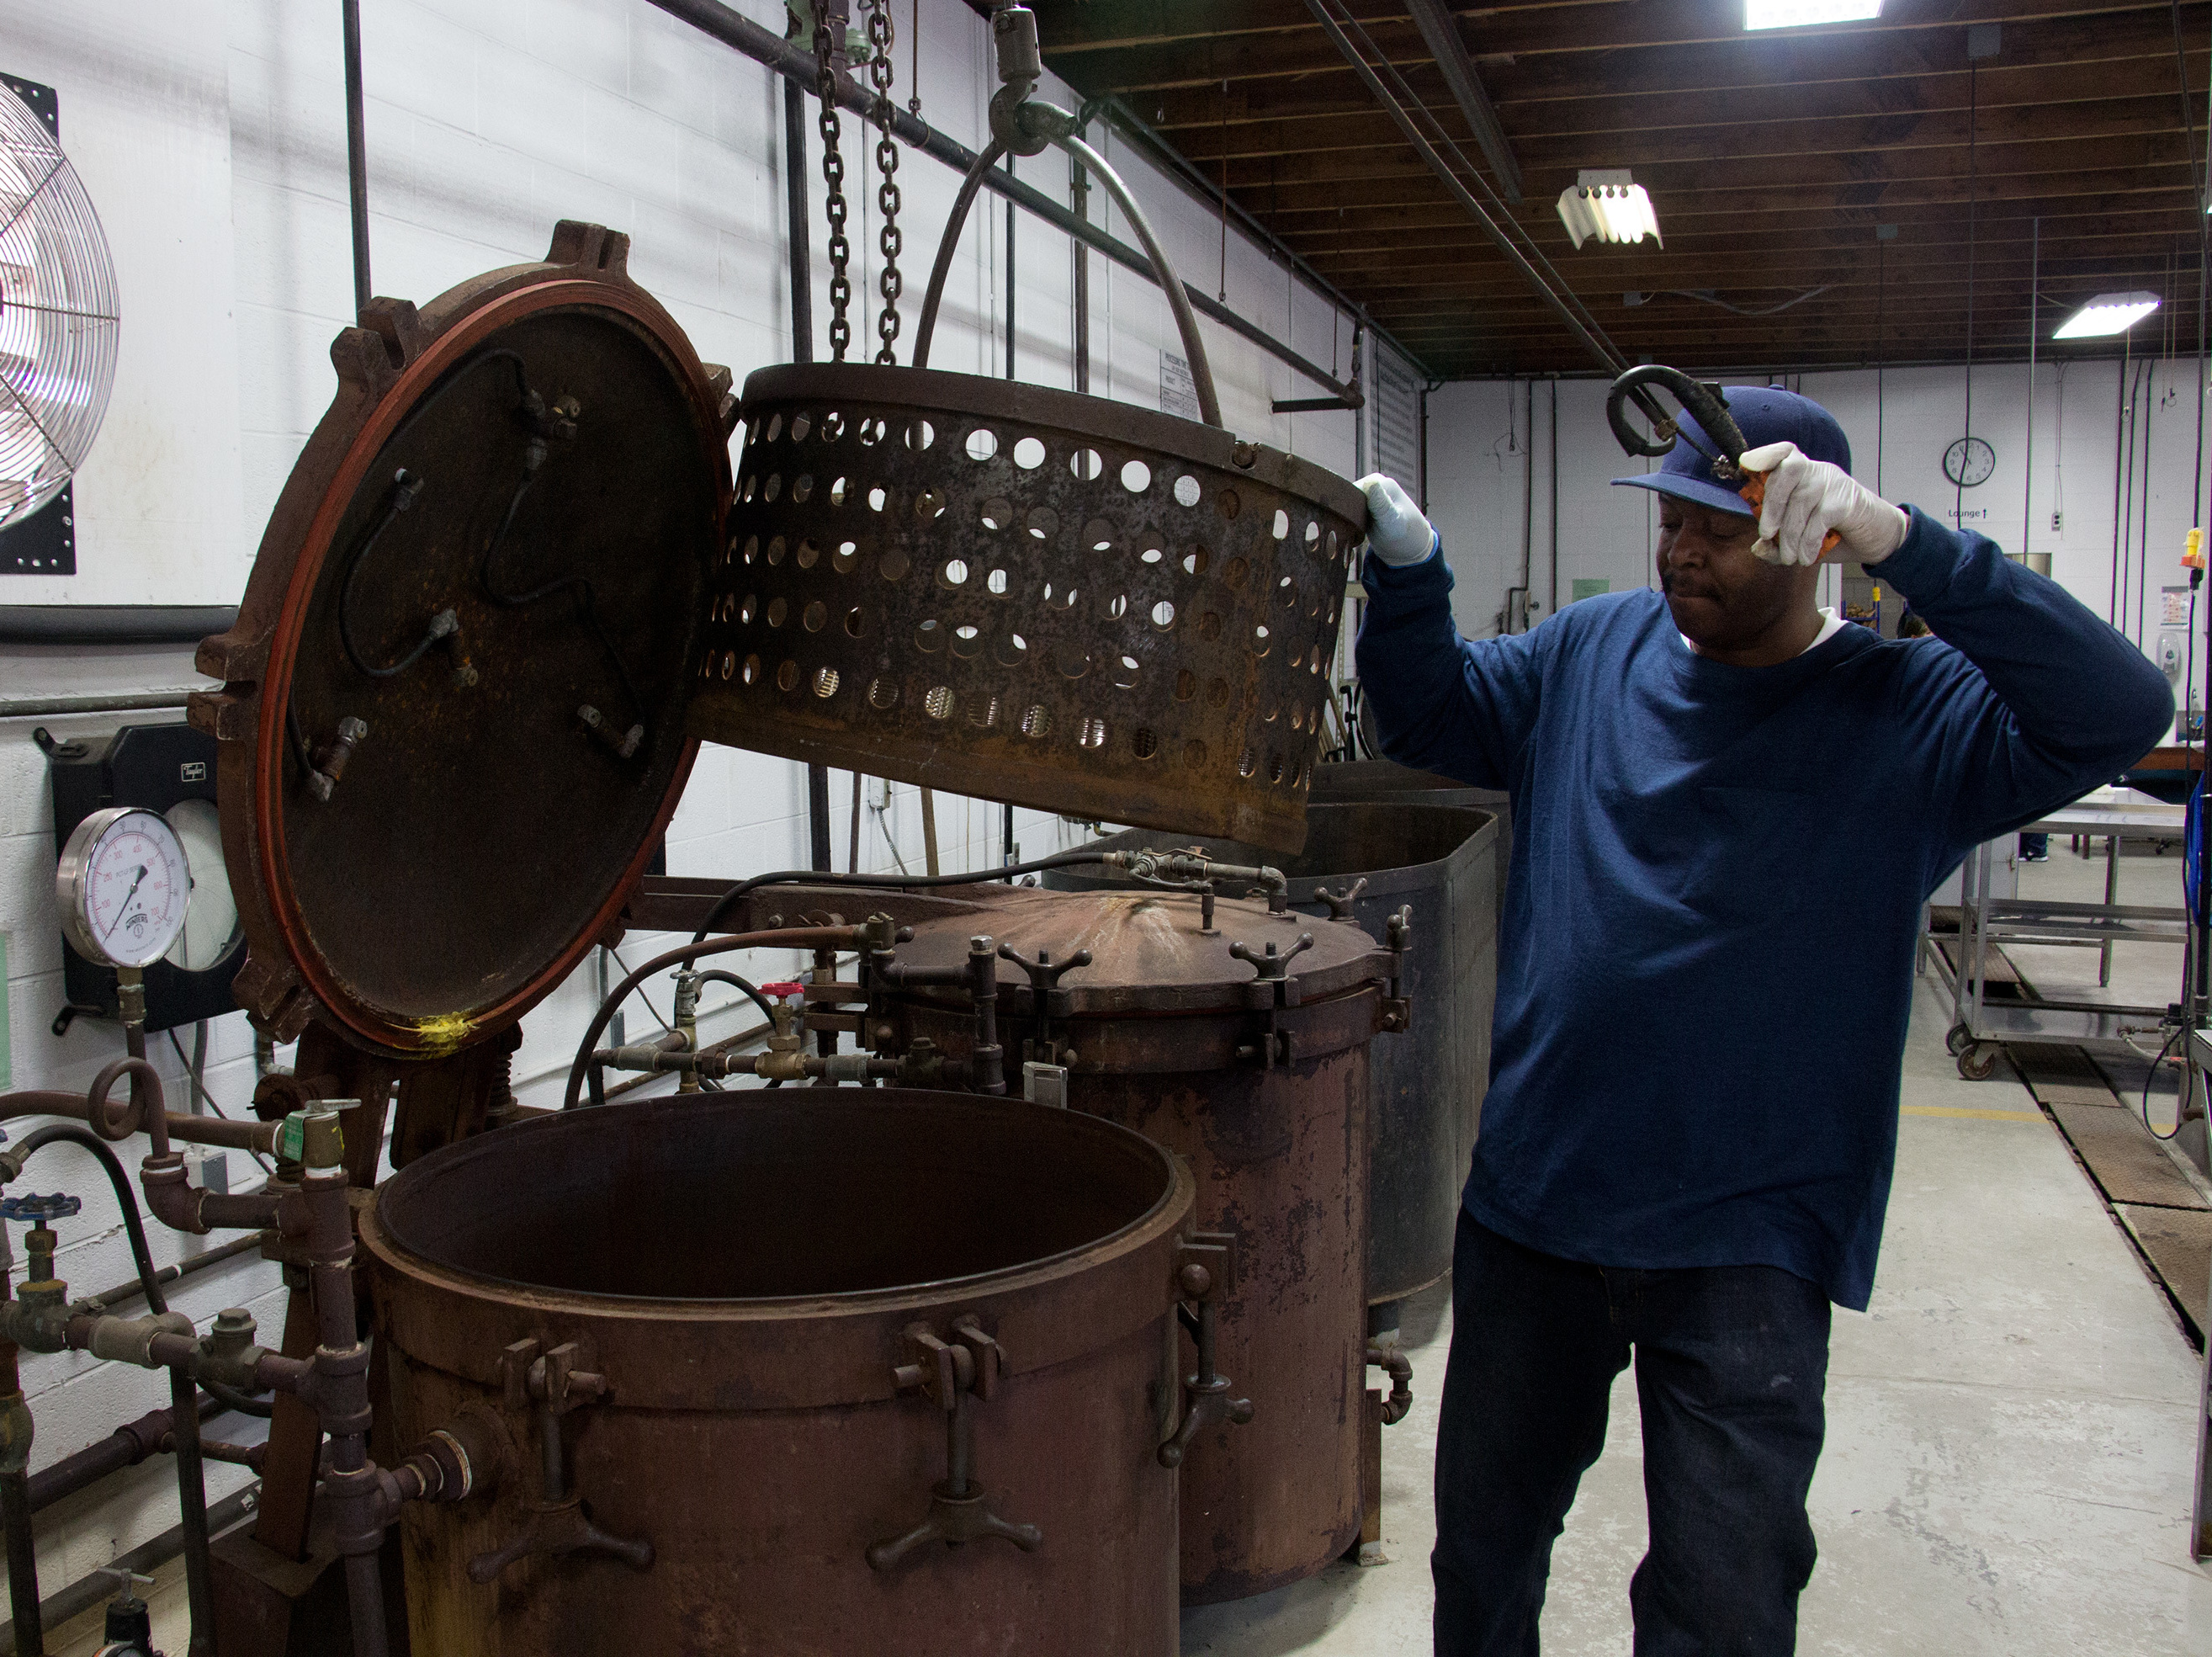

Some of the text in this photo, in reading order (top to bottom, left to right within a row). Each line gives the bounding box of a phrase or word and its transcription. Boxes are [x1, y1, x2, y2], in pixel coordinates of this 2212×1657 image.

[1948, 509, 1981, 518] Lounge
[183, 764, 203, 779] Taylor
[133, 844, 142, 853] 400
[114, 850, 123, 861] 300
[147, 857, 156, 868] 500
[154, 880, 162, 890] 600
[102, 899, 110, 909] 100
[126, 916, 148, 931] WINTERS
